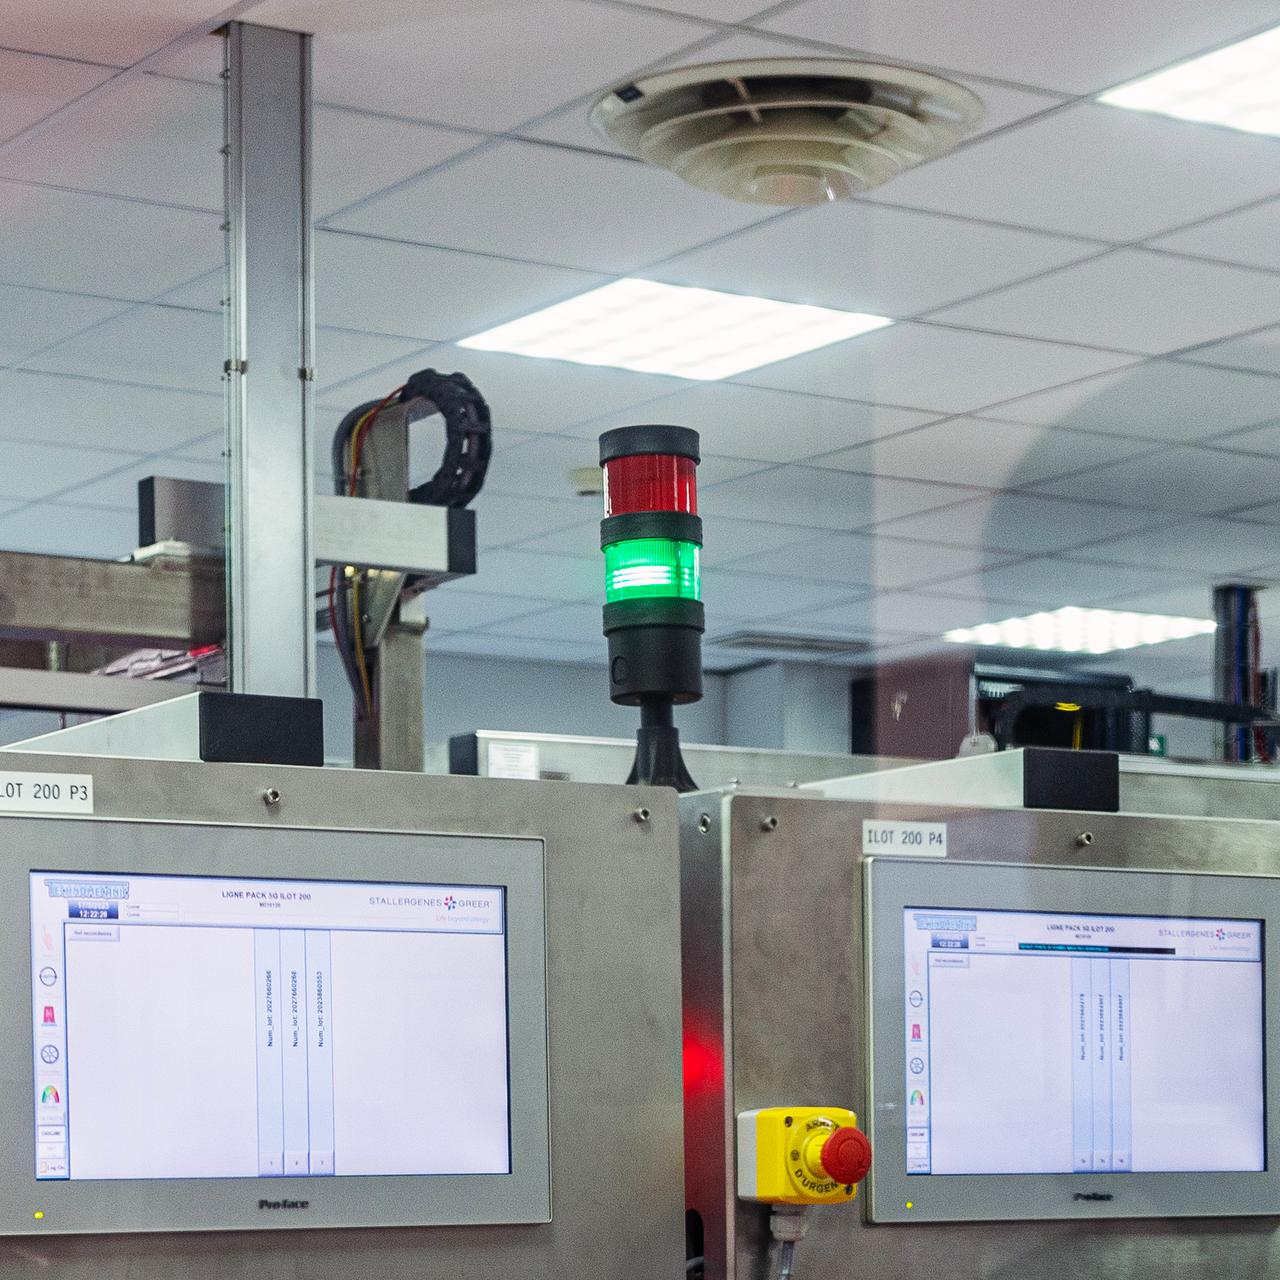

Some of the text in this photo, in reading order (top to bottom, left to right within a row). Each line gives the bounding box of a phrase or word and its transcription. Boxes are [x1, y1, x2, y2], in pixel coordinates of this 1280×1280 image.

[33, 783, 60, 799] 200
[70, 785, 88, 800] P3
[868, 830, 942, 845] ILOT 200 P4
[369, 896, 490, 908] STALLERGENES GREER
[795, 1168, 838, 1193] D'URGEN
